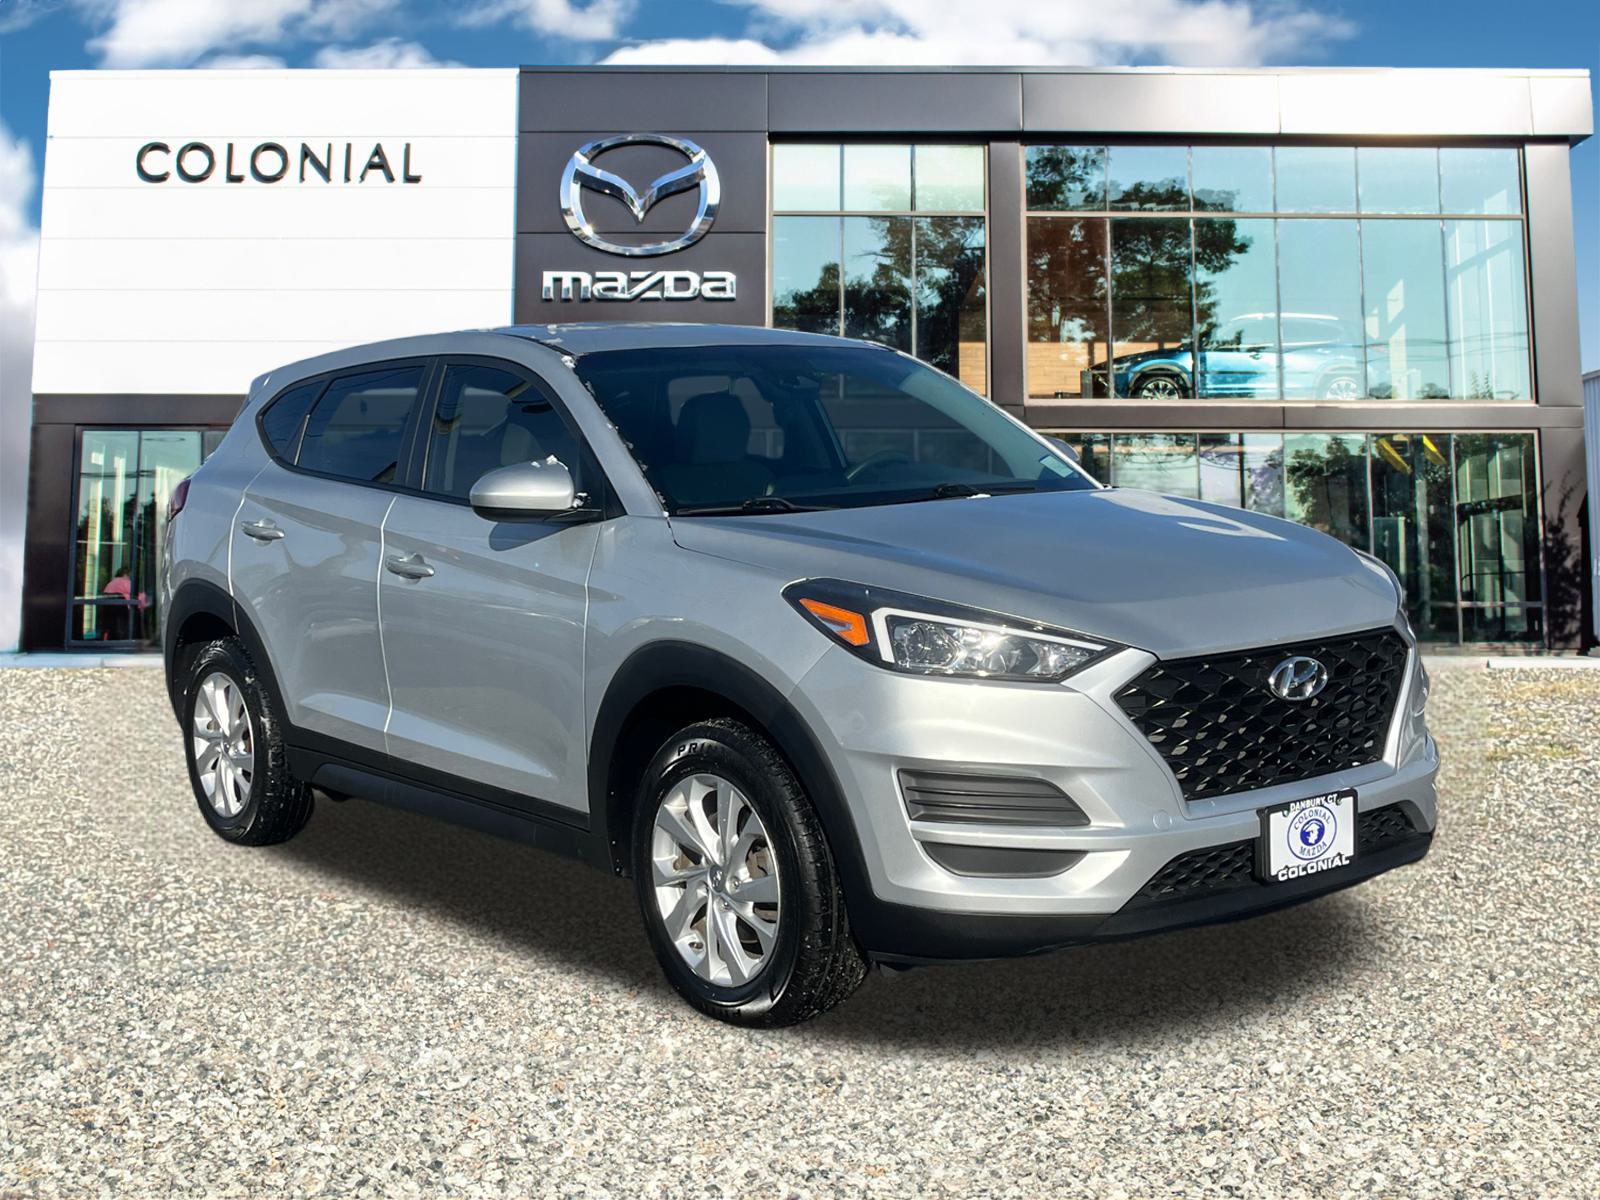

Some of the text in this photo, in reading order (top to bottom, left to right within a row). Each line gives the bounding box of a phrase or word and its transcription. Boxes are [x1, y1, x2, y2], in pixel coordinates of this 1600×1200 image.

[136, 142, 422, 184] COLONIAL
[1290, 794, 1338, 812] DANBURY CT
[1294, 809, 1331, 830] COLONIAL
[1299, 841, 1328, 857] MAZDA
[1278, 855, 1350, 881] COLONIAL
